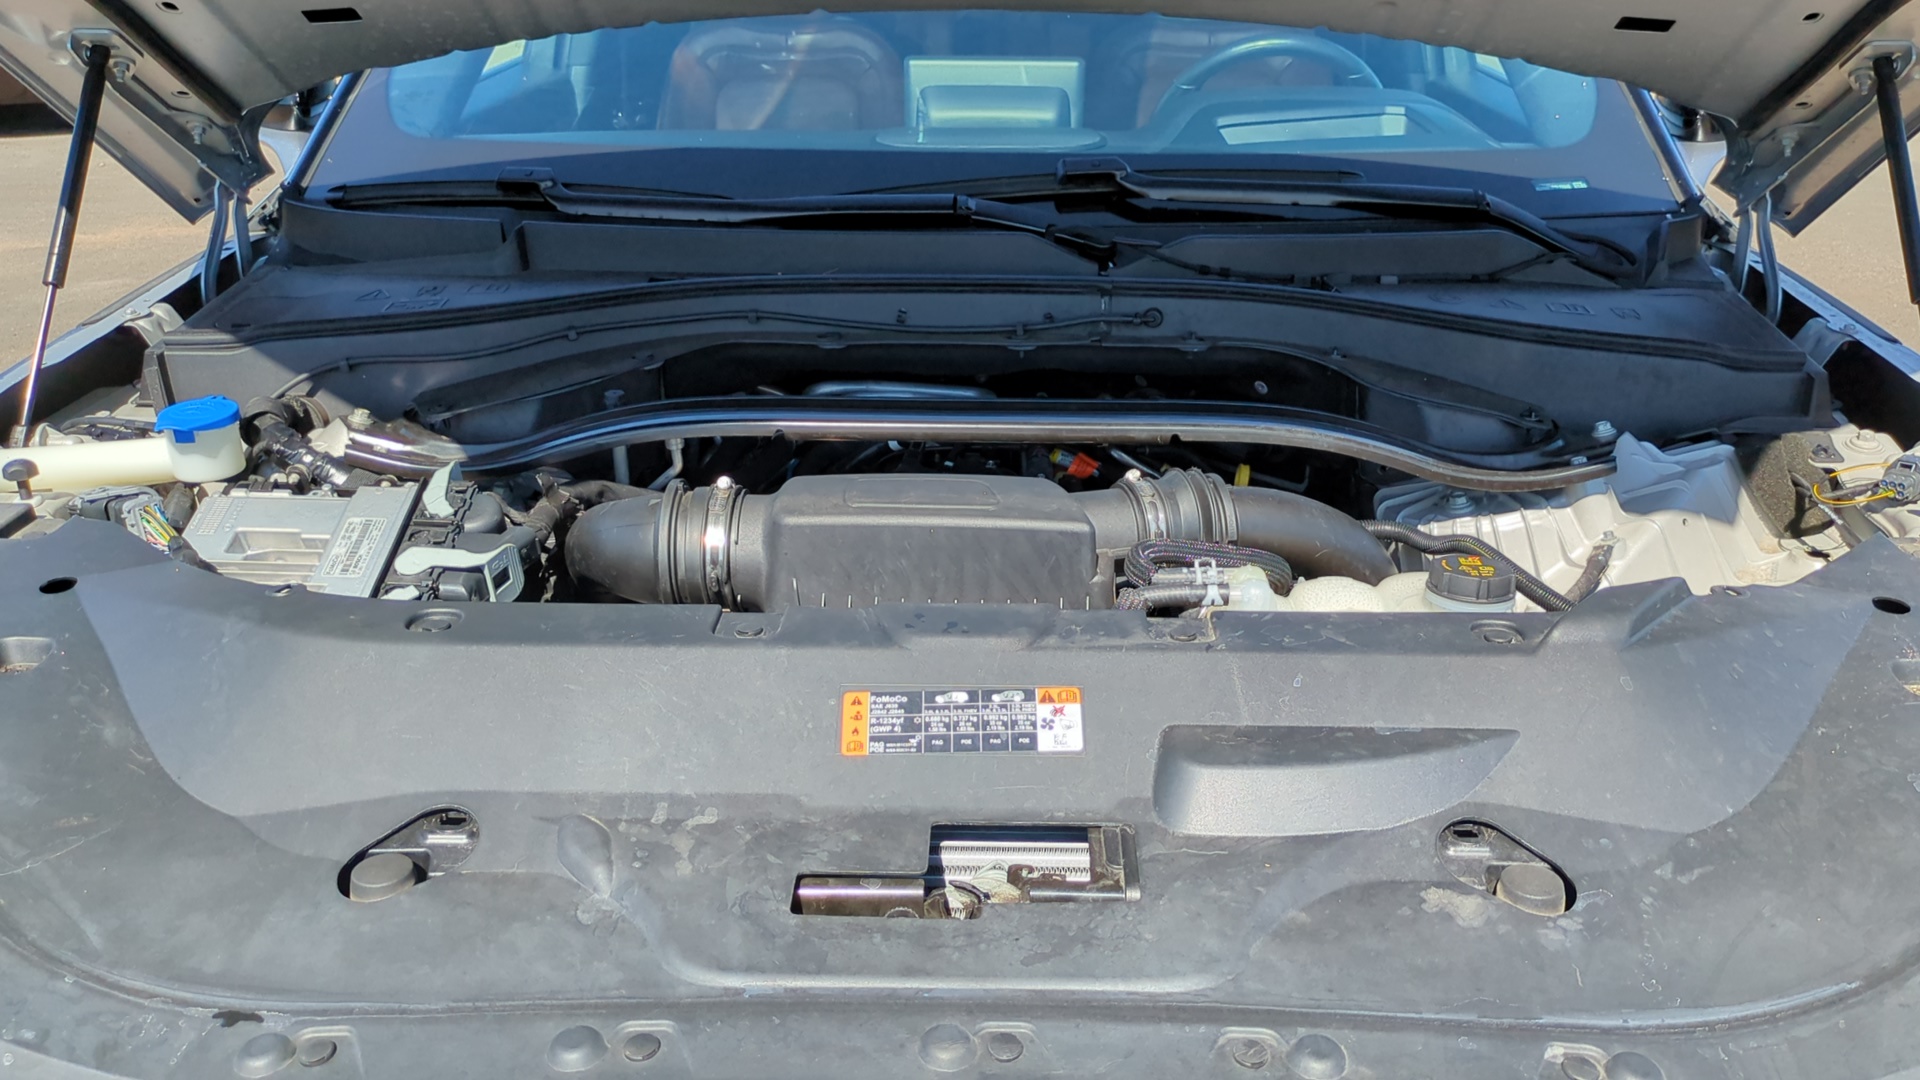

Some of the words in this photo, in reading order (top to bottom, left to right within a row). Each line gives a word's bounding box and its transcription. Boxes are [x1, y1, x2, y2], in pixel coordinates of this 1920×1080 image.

[870, 695, 908, 703] FoMoCo
[870, 717, 904, 725] R-1234yf
[870, 725, 892, 733] (GWP
